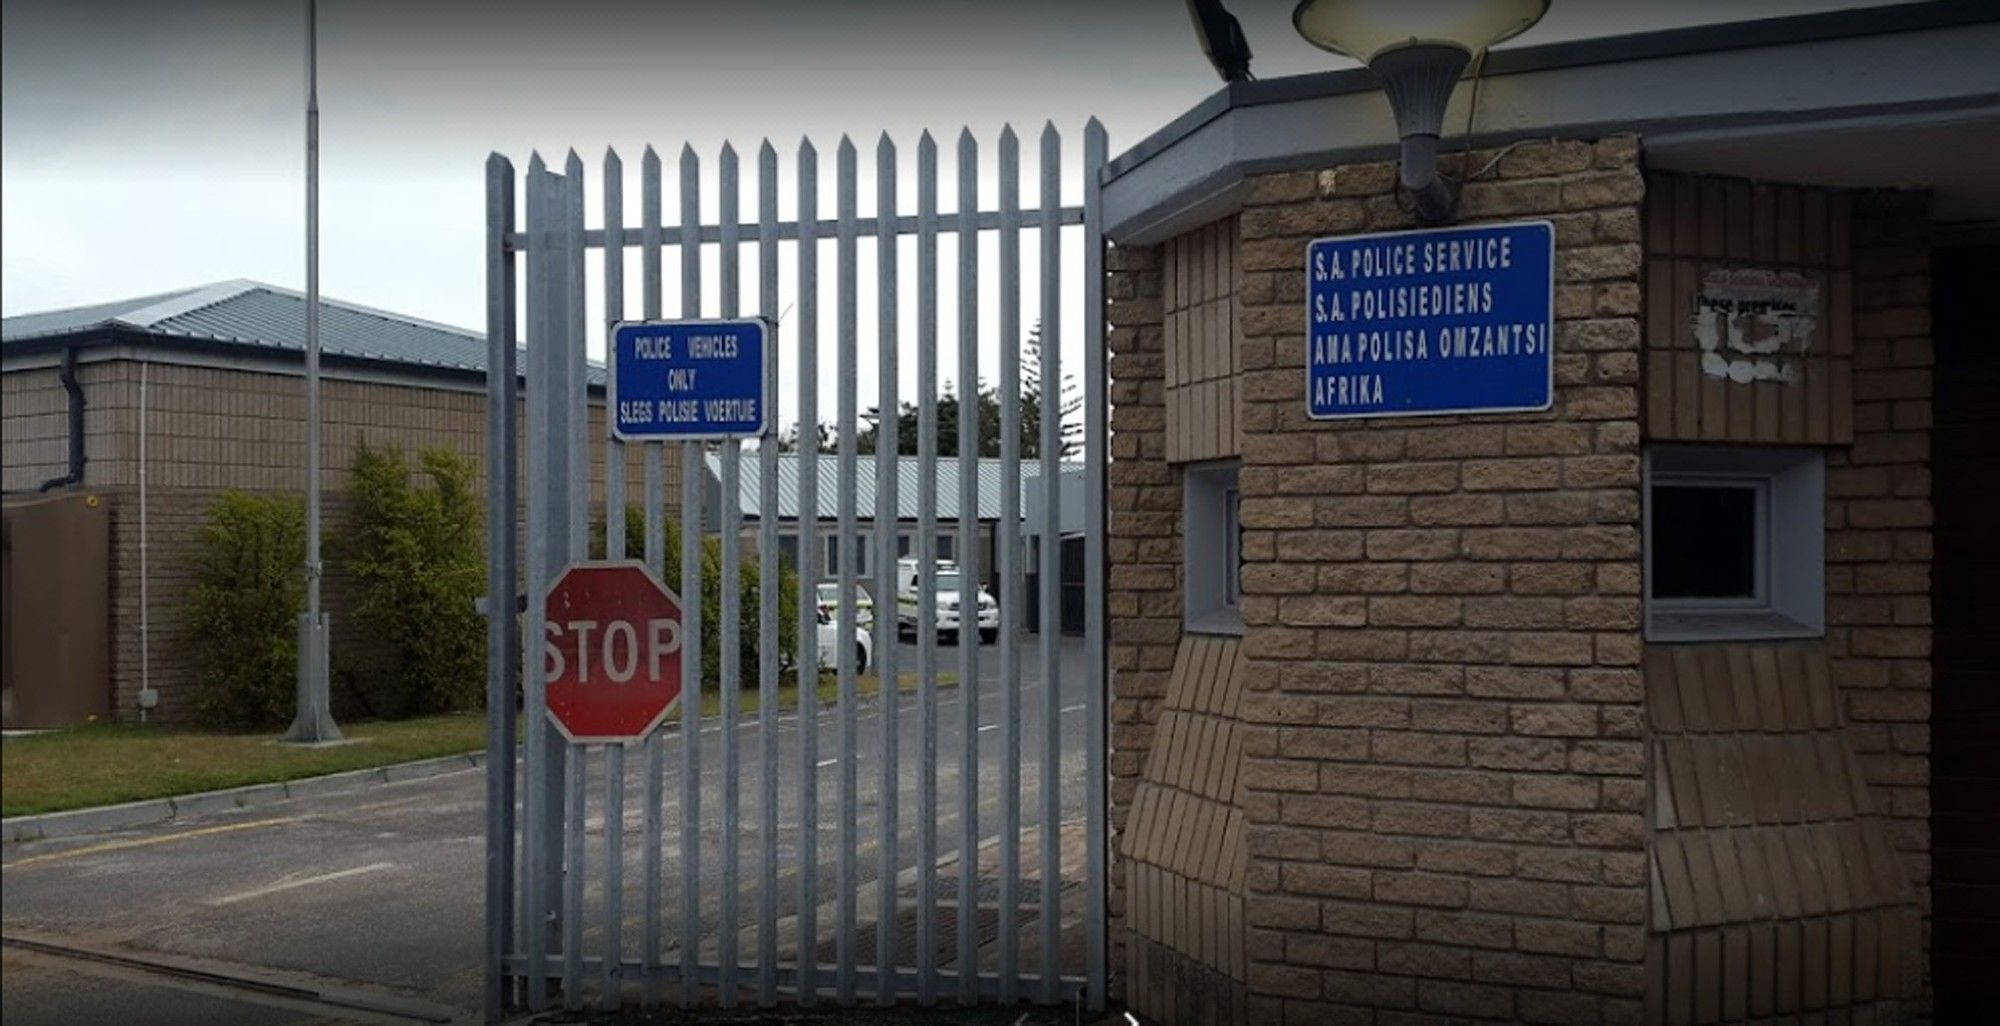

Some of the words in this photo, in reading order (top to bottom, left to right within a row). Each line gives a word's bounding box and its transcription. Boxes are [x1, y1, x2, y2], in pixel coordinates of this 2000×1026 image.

[1315, 250, 1344, 282] S.A.
[1352, 244, 1416, 278] POLICE
[1424, 237, 1511, 273] SERVICE
[1315, 292, 1344, 322] S.A.
[1352, 282, 1492, 320] POLISIEDIENS
[634, 336, 672, 360] POLICE
[687, 335, 737, 359] VEHICLES
[1315, 333, 1351, 365] AMA
[1358, 329, 1428, 362] POLISA
[1439, 323, 1545, 358] OMZANTSI
[668, 368, 697, 392] ONLY
[1314, 374, 1384, 406] AFRIKA
[620, 401, 653, 424] SLEGS
[659, 400, 699, 423] POLISIE
[704, 398, 756, 422] VOERTUIE
[545, 618, 682, 683] STOP
